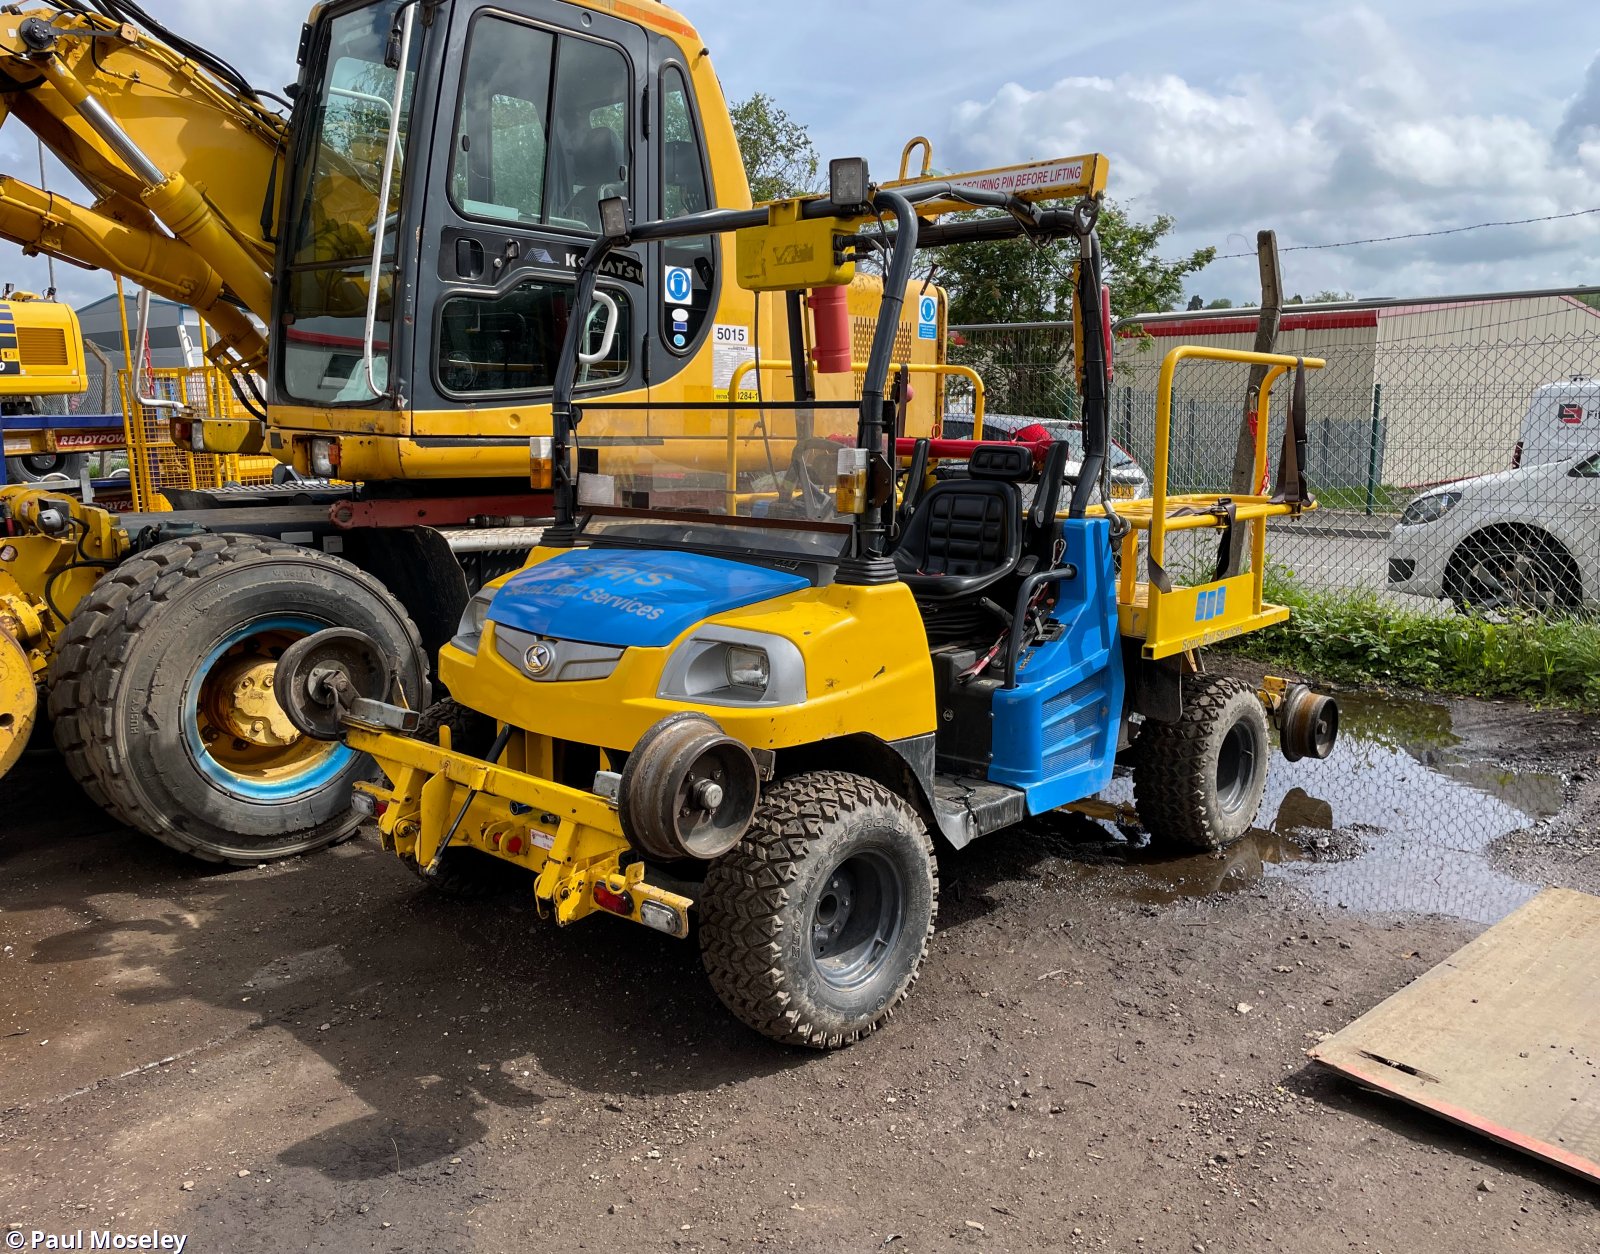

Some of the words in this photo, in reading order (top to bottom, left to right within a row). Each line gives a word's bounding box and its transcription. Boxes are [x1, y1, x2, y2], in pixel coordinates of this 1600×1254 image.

[1001, 175, 1015, 189] PIN
[1016, 171, 1048, 187] BEFORE
[1050, 166, 1082, 182] LIFTING
[717, 327, 745, 342] 5015
[582, 588, 664, 620] Services
[129, 699, 140, 736] HUSKY
